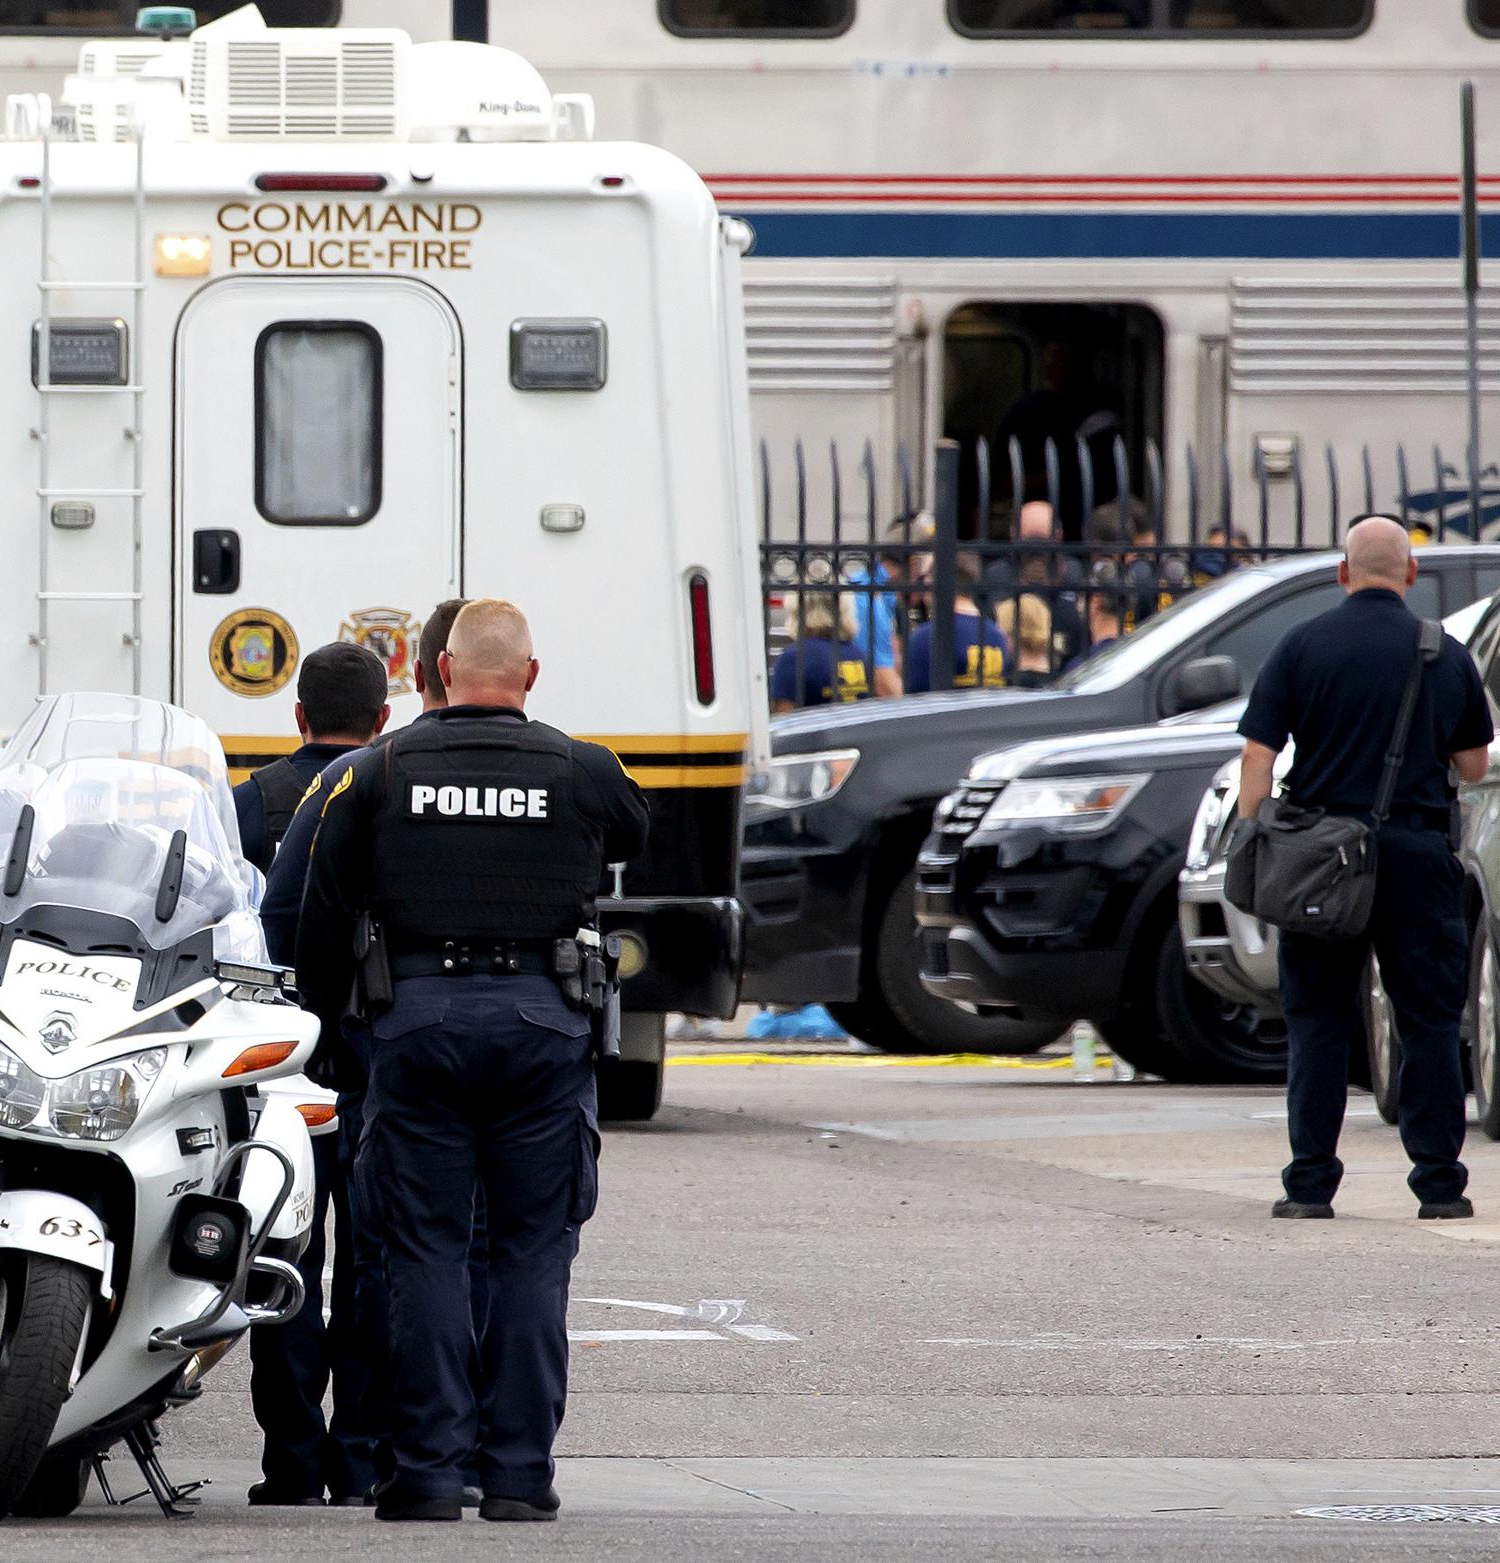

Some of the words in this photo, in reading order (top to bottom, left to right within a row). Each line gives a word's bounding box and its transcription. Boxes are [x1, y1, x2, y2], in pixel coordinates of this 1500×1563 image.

[216, 202, 483, 233] COMMAND
[228, 239, 473, 269] POLICE-FIRE
[411, 785, 549, 818] POLICE
[16, 961, 132, 993] POLICE
[39, 1216, 102, 1246] 637
